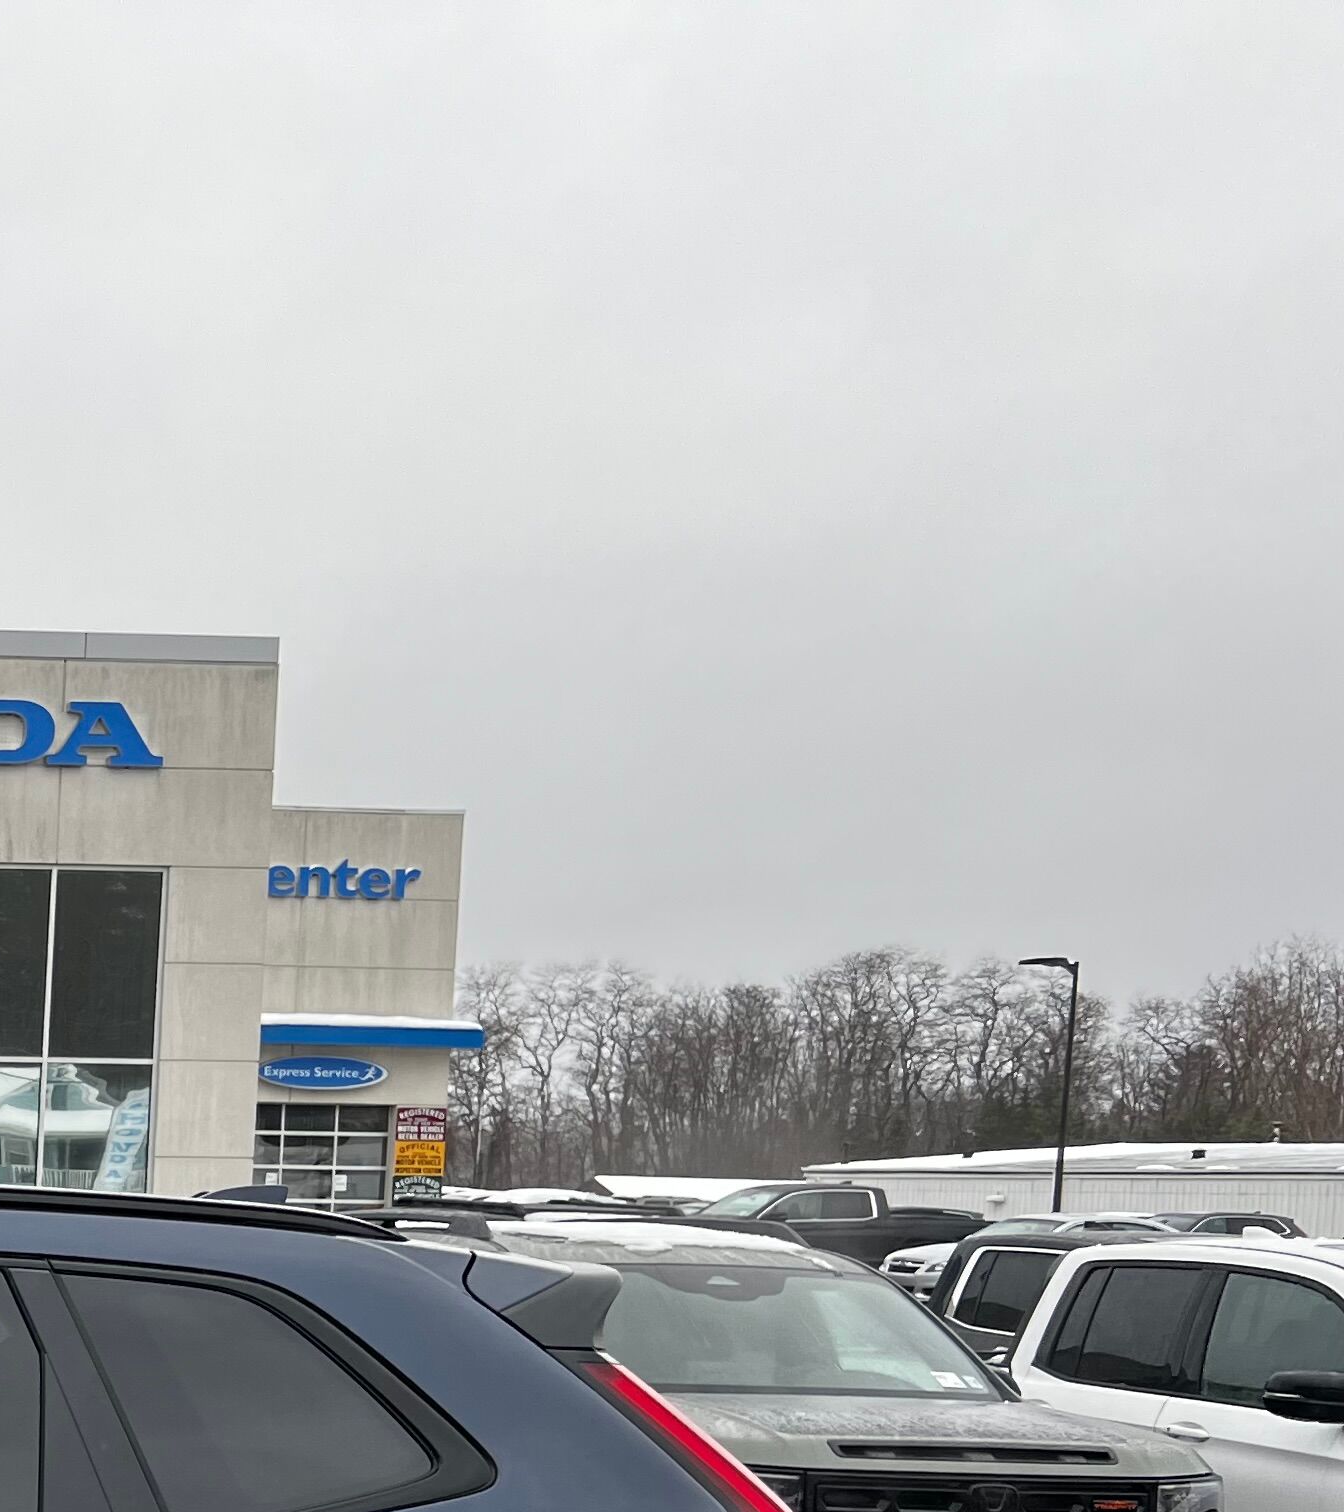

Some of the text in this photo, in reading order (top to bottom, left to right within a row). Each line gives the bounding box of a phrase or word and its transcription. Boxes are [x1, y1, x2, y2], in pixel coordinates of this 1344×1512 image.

[263, 1065, 360, 1080] Express Service
[398, 1108, 445, 1121] REGISTERED
[399, 1143, 441, 1154] OFFICIAL
